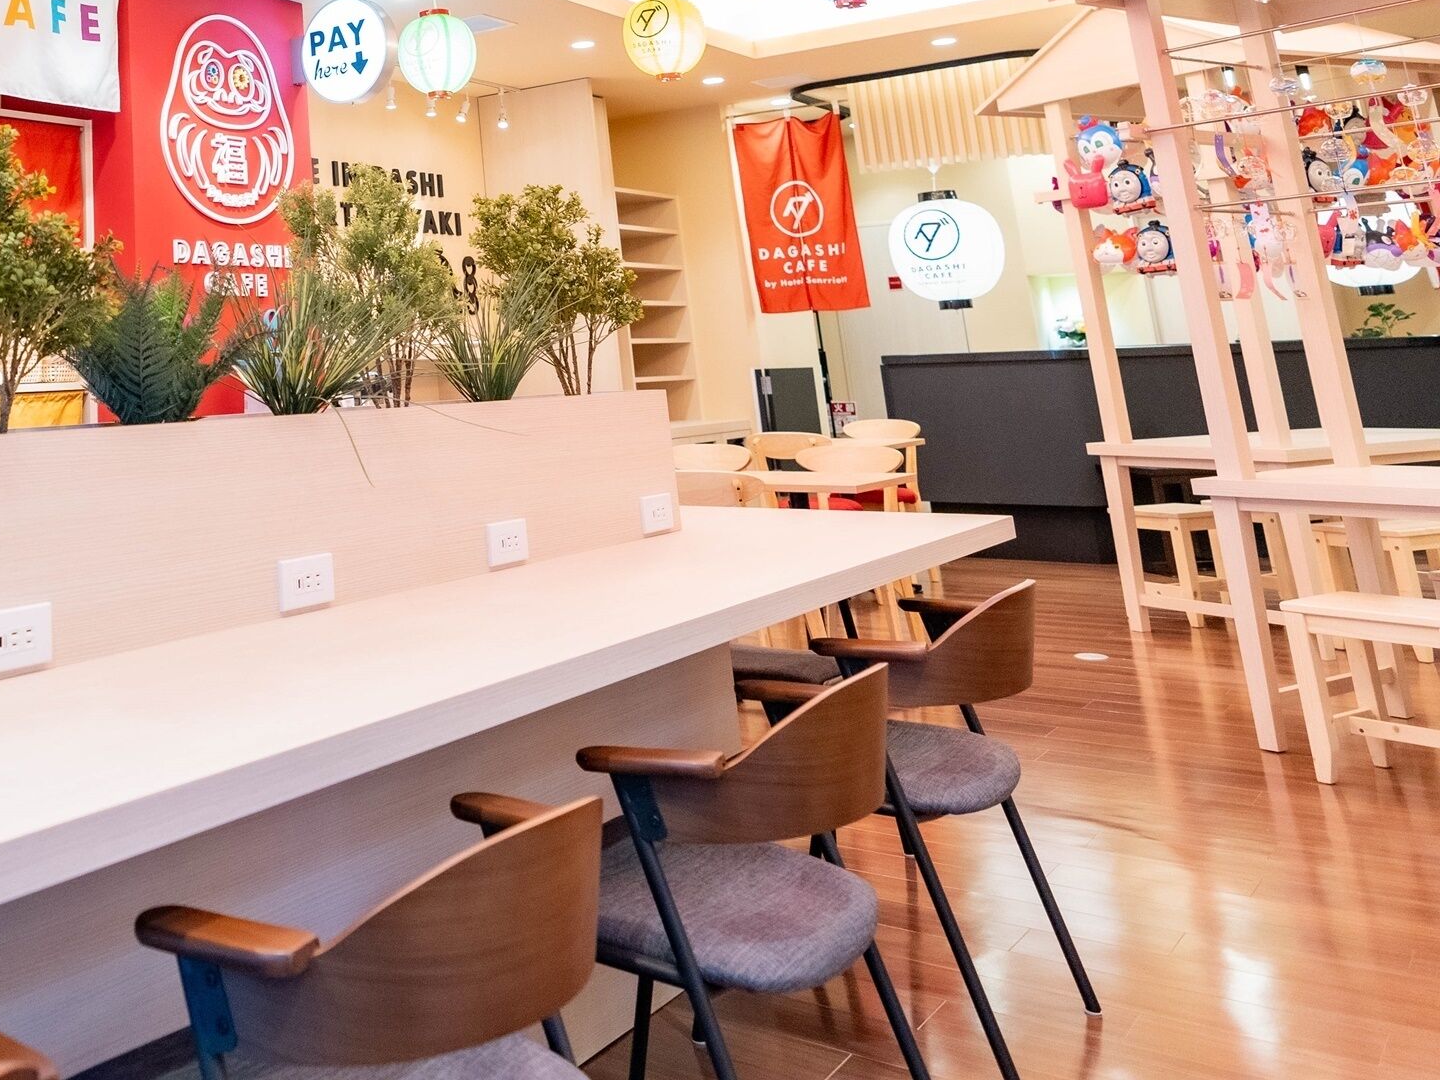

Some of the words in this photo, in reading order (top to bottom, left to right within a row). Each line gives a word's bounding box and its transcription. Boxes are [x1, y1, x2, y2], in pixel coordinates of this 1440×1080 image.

[310, 19, 365, 56] PAY
[314, 59, 347, 80] here
[173, 239, 293, 268] DAGASHI
[758, 242, 845, 260] DAGASHI
[783, 259, 828, 274] CAFE
[764, 280, 777, 289] by
